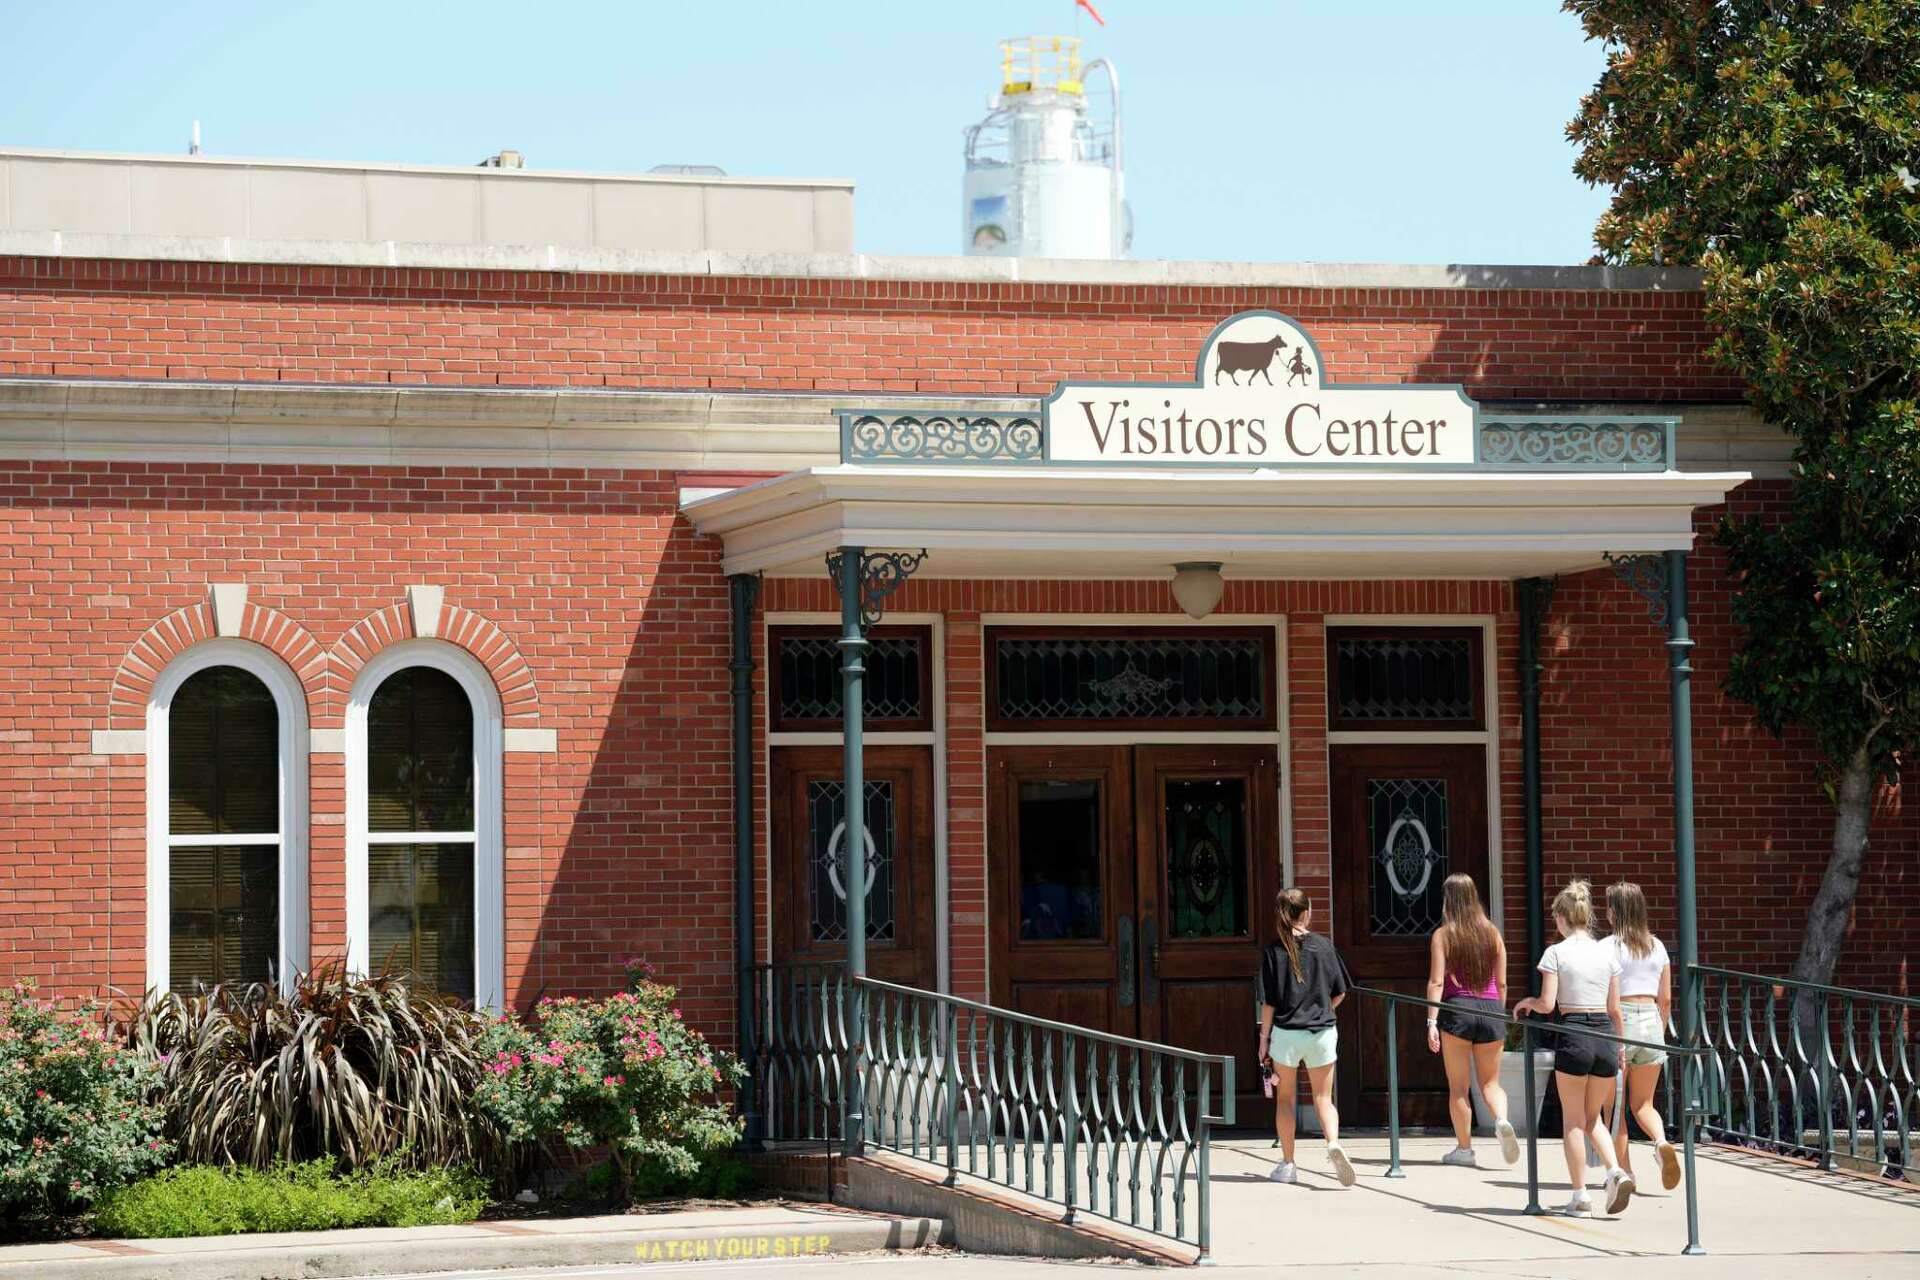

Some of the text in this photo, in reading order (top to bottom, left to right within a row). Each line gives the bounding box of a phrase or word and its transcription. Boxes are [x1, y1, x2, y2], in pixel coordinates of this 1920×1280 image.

[1078, 399, 1447, 458] Visitors Center
[635, 1235, 832, 1259] WATCH YOUR STEP
